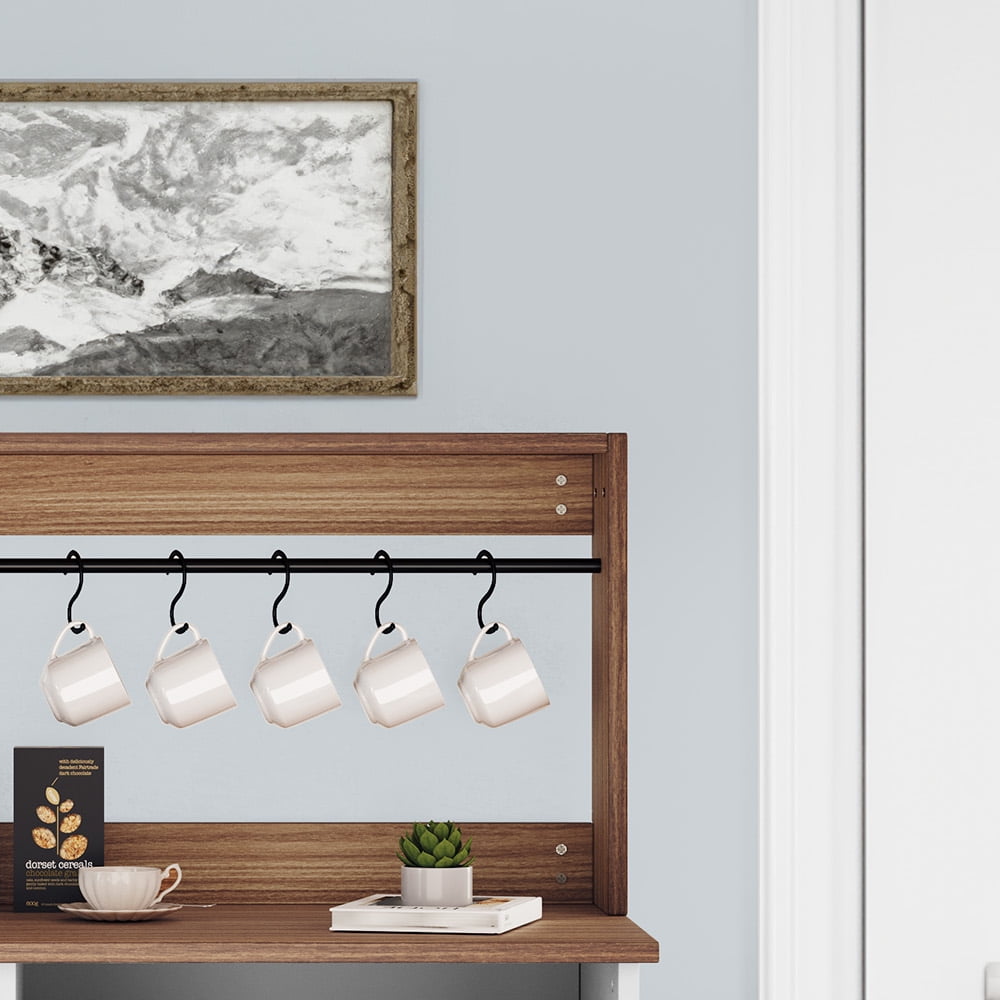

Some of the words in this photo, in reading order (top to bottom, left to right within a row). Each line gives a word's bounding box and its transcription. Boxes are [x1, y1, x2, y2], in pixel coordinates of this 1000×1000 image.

[25, 859, 56, 869] dorset
[58, 859, 93, 869] cereals
[25, 869, 62, 877] chocolate
